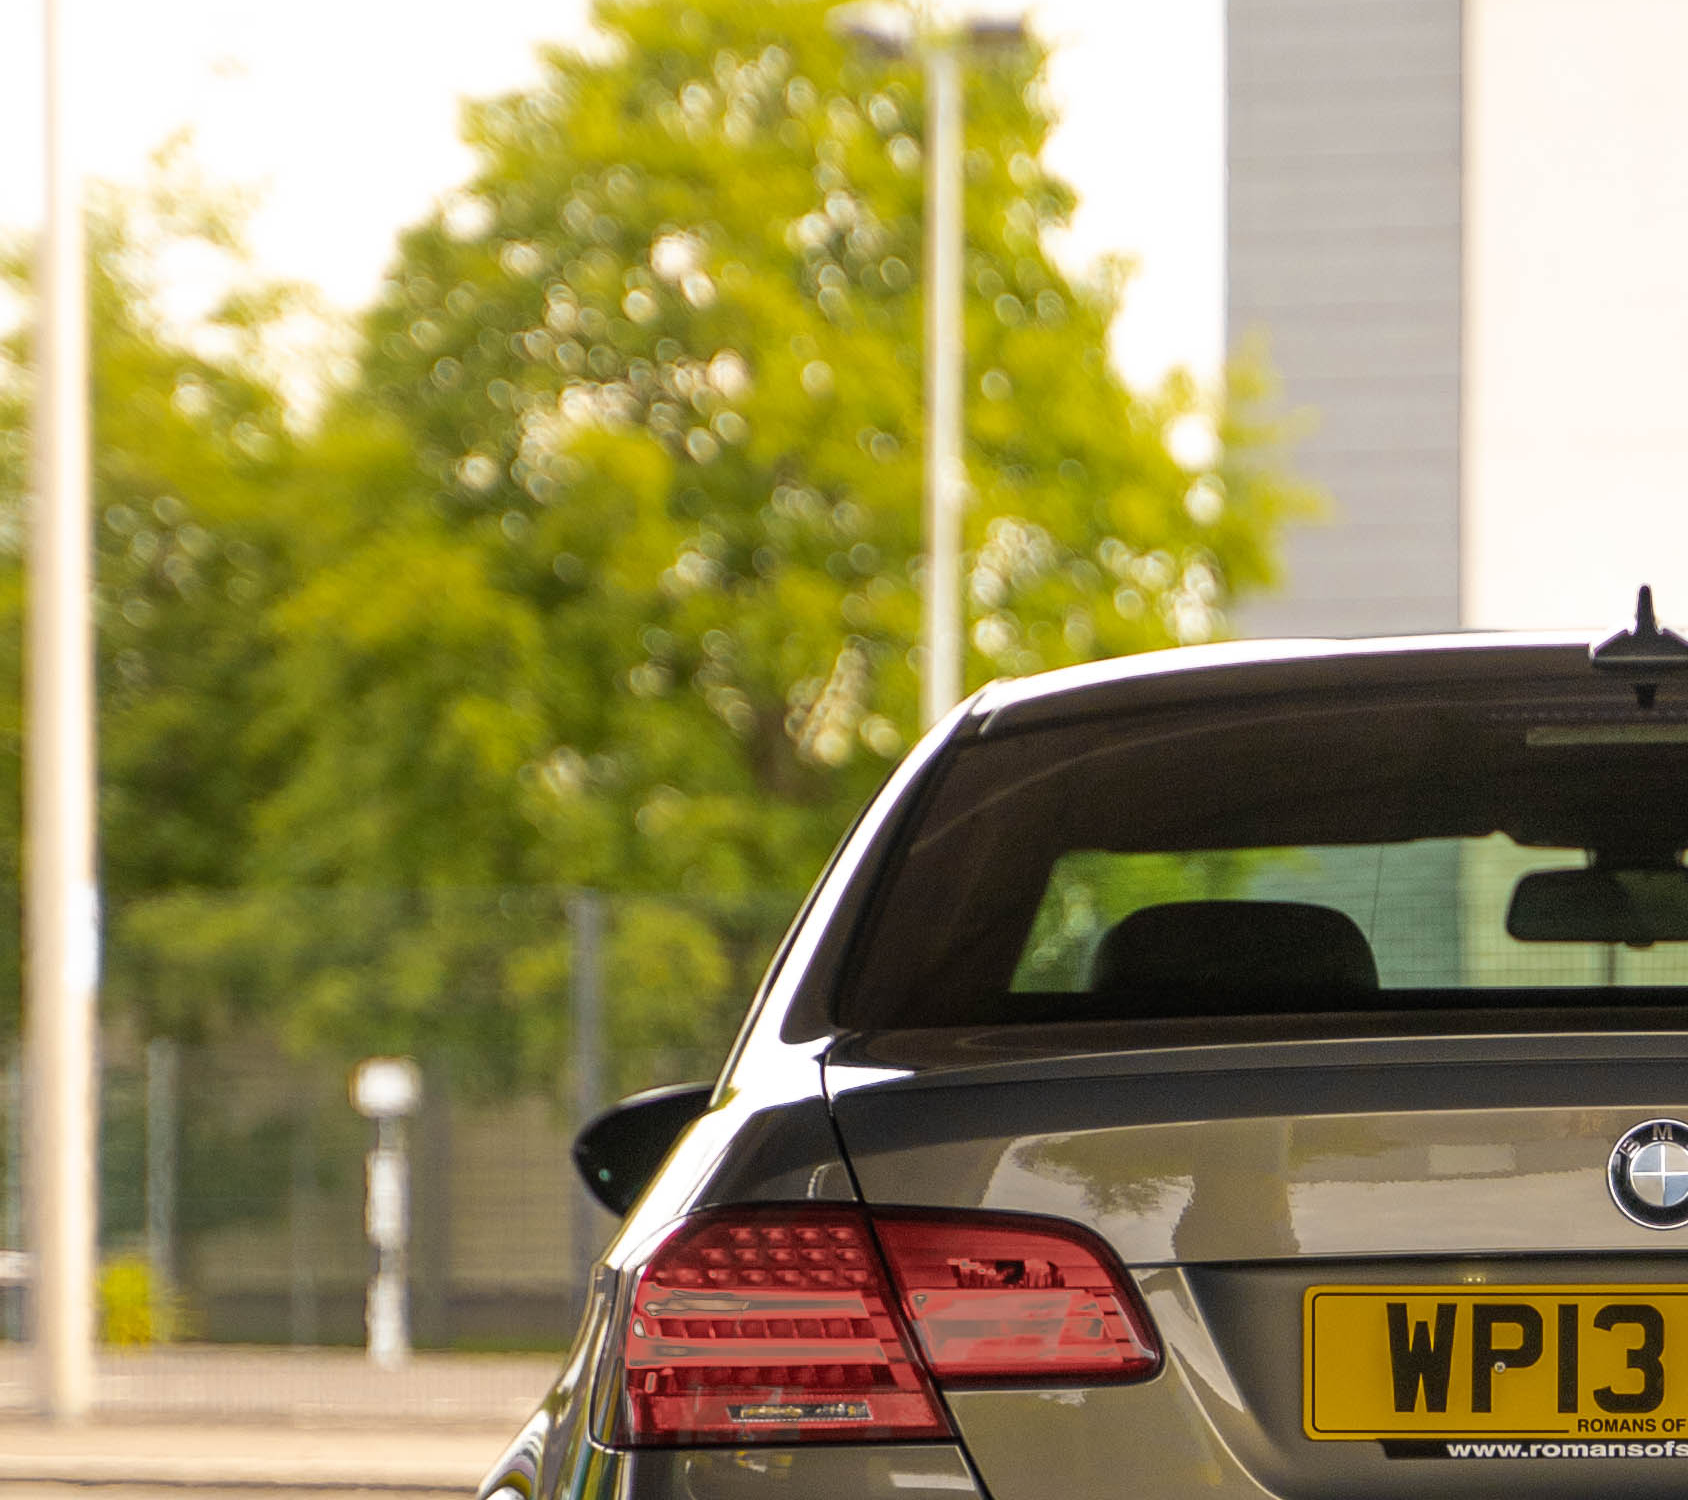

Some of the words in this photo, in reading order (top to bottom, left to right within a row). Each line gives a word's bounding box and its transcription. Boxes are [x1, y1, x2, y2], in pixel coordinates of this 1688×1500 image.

[1387, 1303, 1665, 1414] WP13
[1577, 1418, 1657, 1433] ROMANS
[1661, 1418, 1687, 1433] OF
